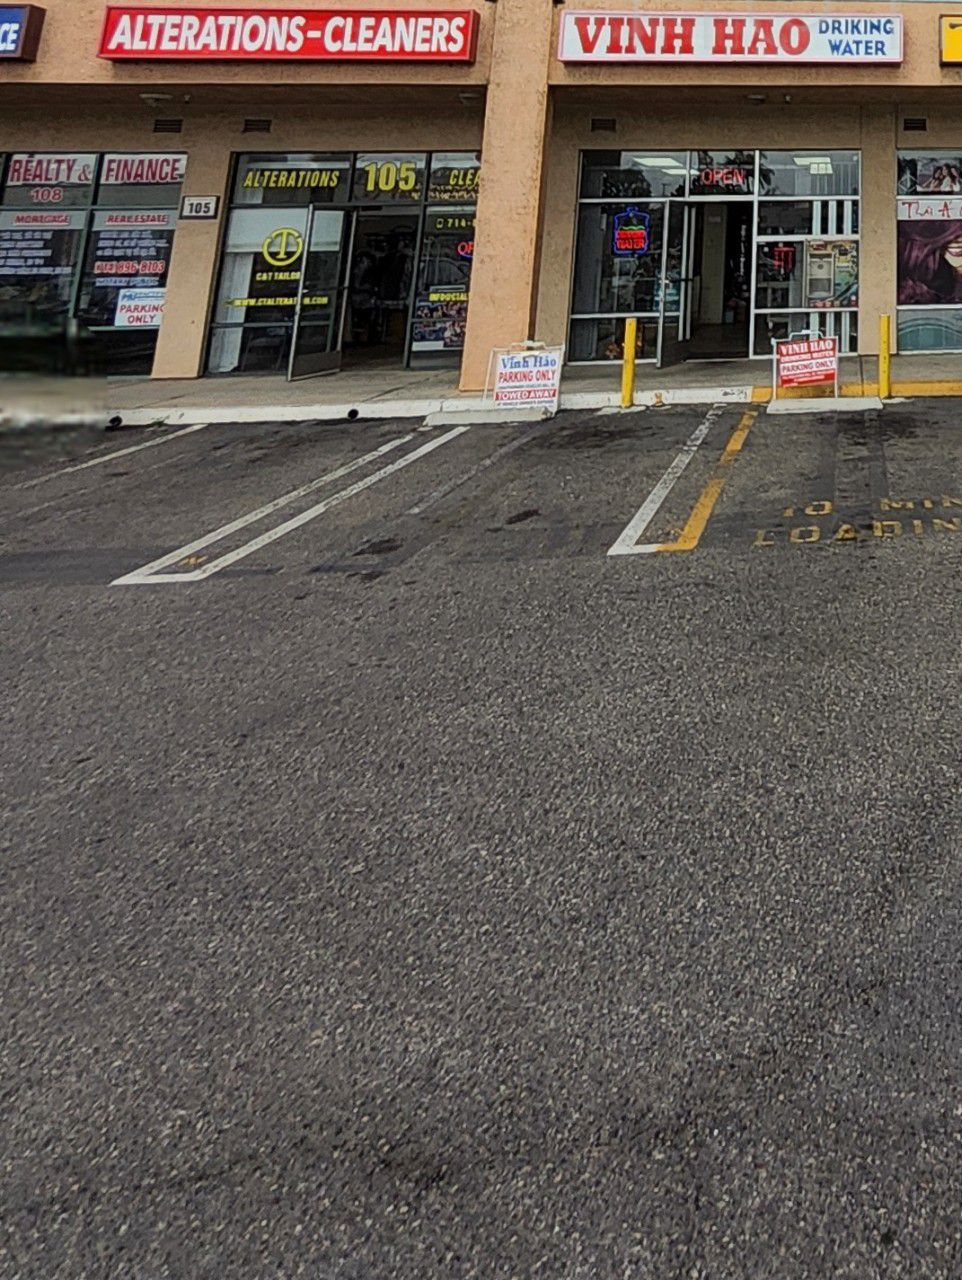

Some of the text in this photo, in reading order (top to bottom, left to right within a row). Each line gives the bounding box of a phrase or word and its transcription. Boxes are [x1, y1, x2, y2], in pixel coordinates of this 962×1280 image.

[0, 22, 20, 51] CE
[574, 16, 895, 56] VINH HAO DRIKING
[827, 39, 887, 56] WATER
[10, 158, 91, 183] REALTY &
[105, 157, 182, 182] FINANCE
[363, 160, 417, 192] 105
[701, 168, 745, 185] OPEN
[243, 169, 341, 188] ALTERATIONS
[31, 187, 63, 203] 108
[187, 201, 212, 215] 105
[127, 314, 156, 324] ONLY
[780, 339, 834, 356] VINH HAO
[782, 359, 834, 373] PARKING ONLY
[498, 369, 557, 383] PARKING ONLY
[529, 389, 555, 399] AWAY
